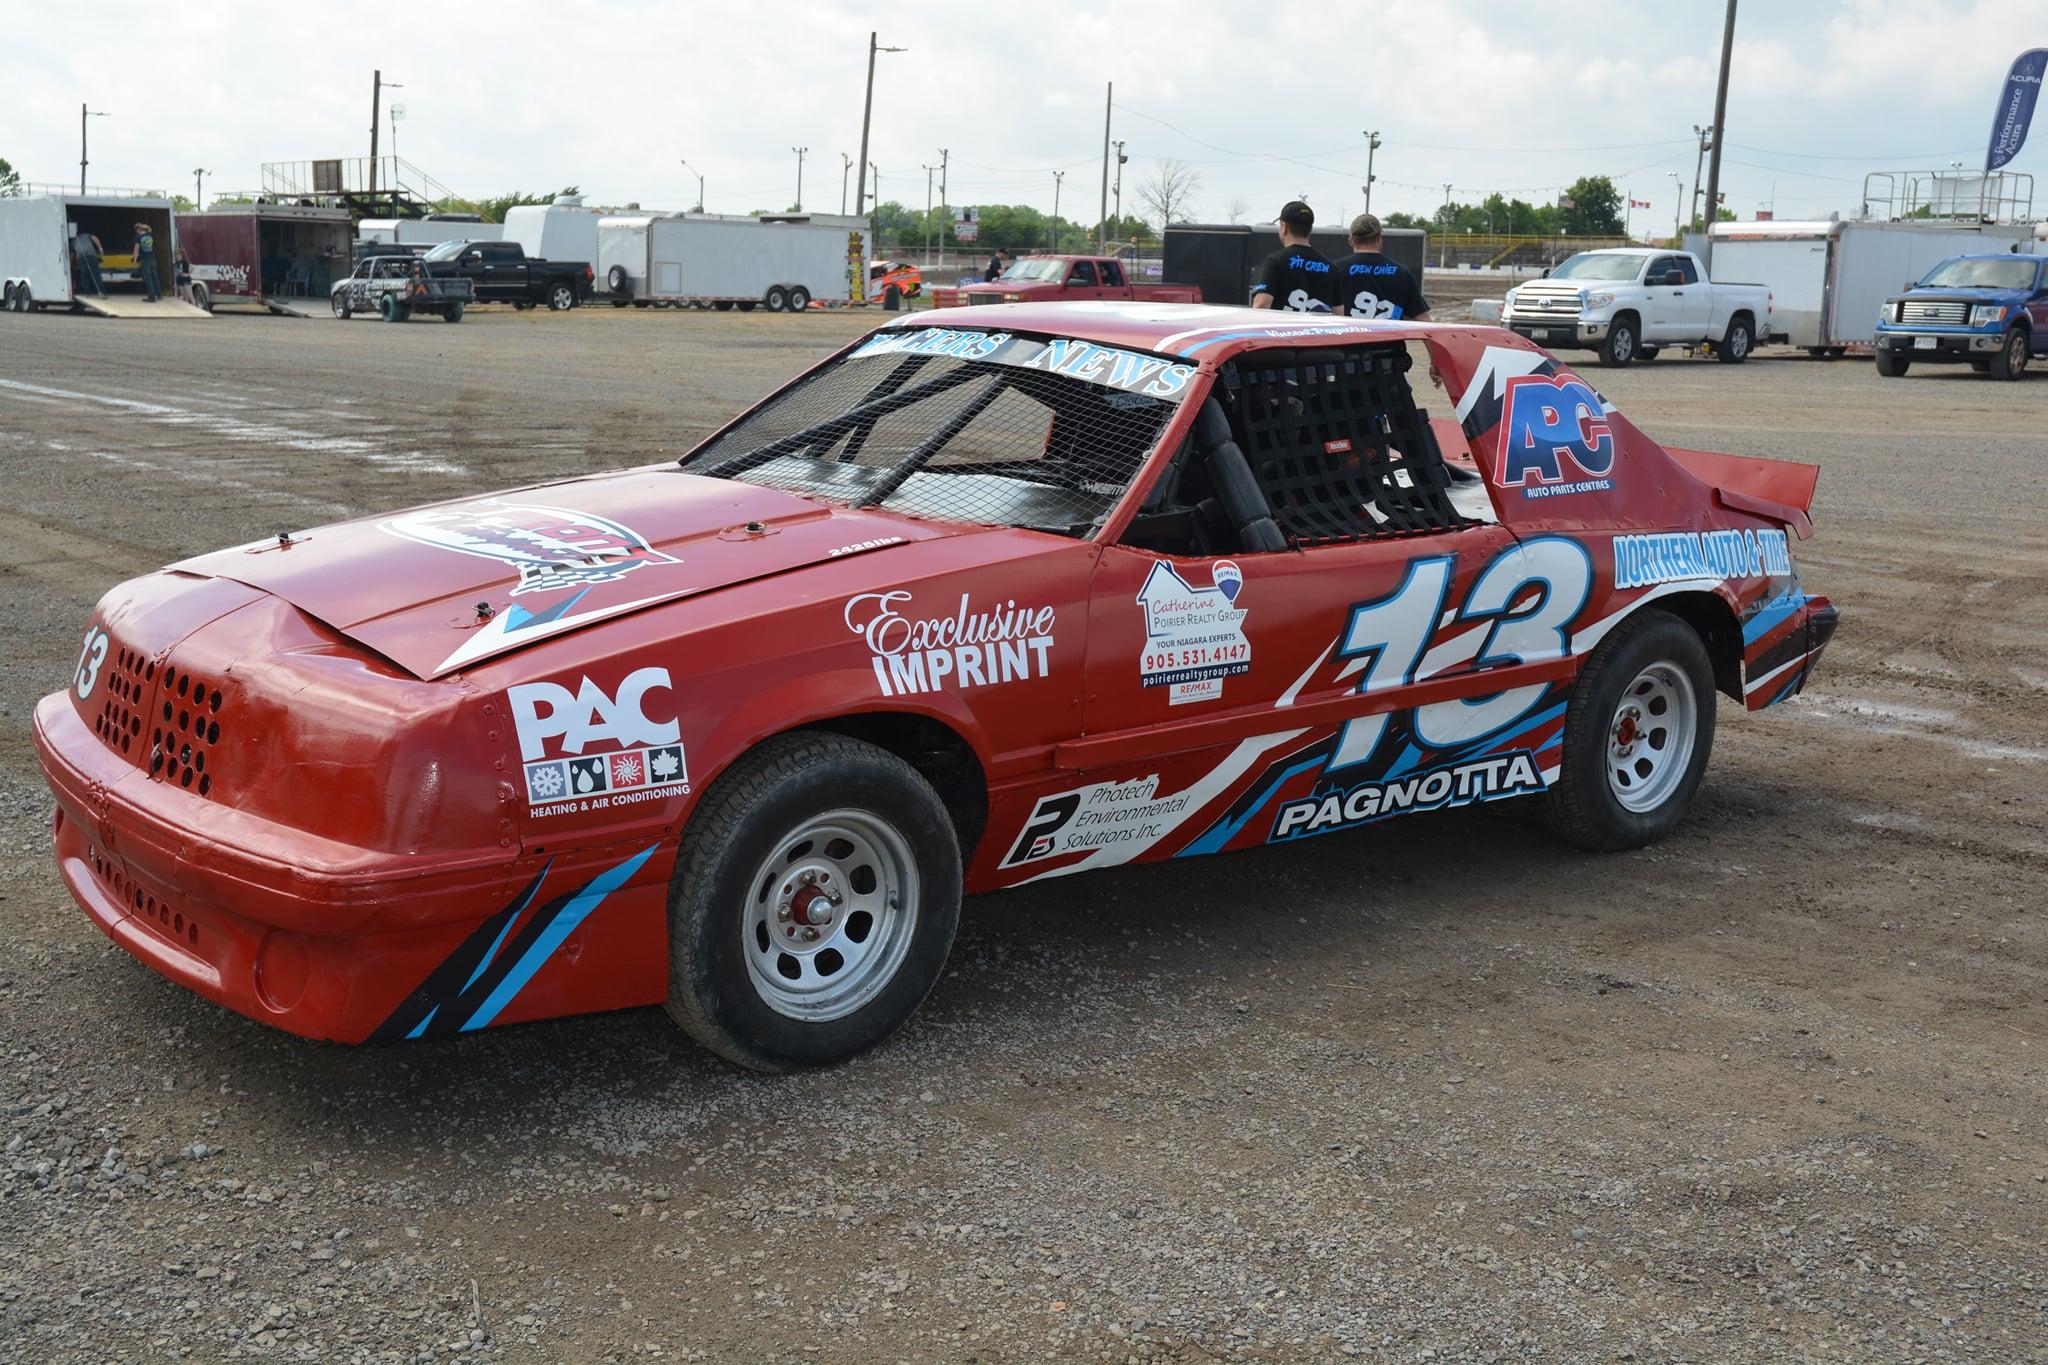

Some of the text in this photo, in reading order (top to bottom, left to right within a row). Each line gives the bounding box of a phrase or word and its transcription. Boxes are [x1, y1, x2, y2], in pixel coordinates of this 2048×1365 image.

[2009, 75, 2041, 83] ACURA
[1994, 88, 2022, 154] Performance
[2005, 123, 2022, 154] Acura
[1288, 255, 1330, 273] PIT CREW
[1349, 263, 1399, 276] CREW CHIEF
[1023, 338, 1199, 397] NEWS
[1527, 479, 1610, 498] AUTO PARTS CENTRES
[1612, 528, 1791, 590] NORTHERN AUTO & TIRE
[1152, 596, 1216, 615] Catherine
[1154, 609, 1246, 629] POIRIER REALTY GROUP
[844, 590, 1055, 656] Exclusive
[1156, 632, 1237, 649] YOUR NIAGARA EXPERTS
[1325, 534, 1592, 772] 13
[72, 624, 110, 700] 13
[871, 635, 1055, 697] IMPRINT
[1146, 643, 1247, 670] 905.531.4147
[1143, 664, 1249, 688] poirierrealtygroup.com
[1180, 682, 1213, 694] RE/MAX
[507, 666, 681, 763] PAC
[530, 784, 691, 818] HEATING & AIR CONDITIONING
[1088, 780, 1155, 804] Photech
[1275, 754, 1539, 837] PAGNOTTA
[1075, 795, 1191, 828] Environmental
[1062, 822, 1162, 850] Solutions Inc.
